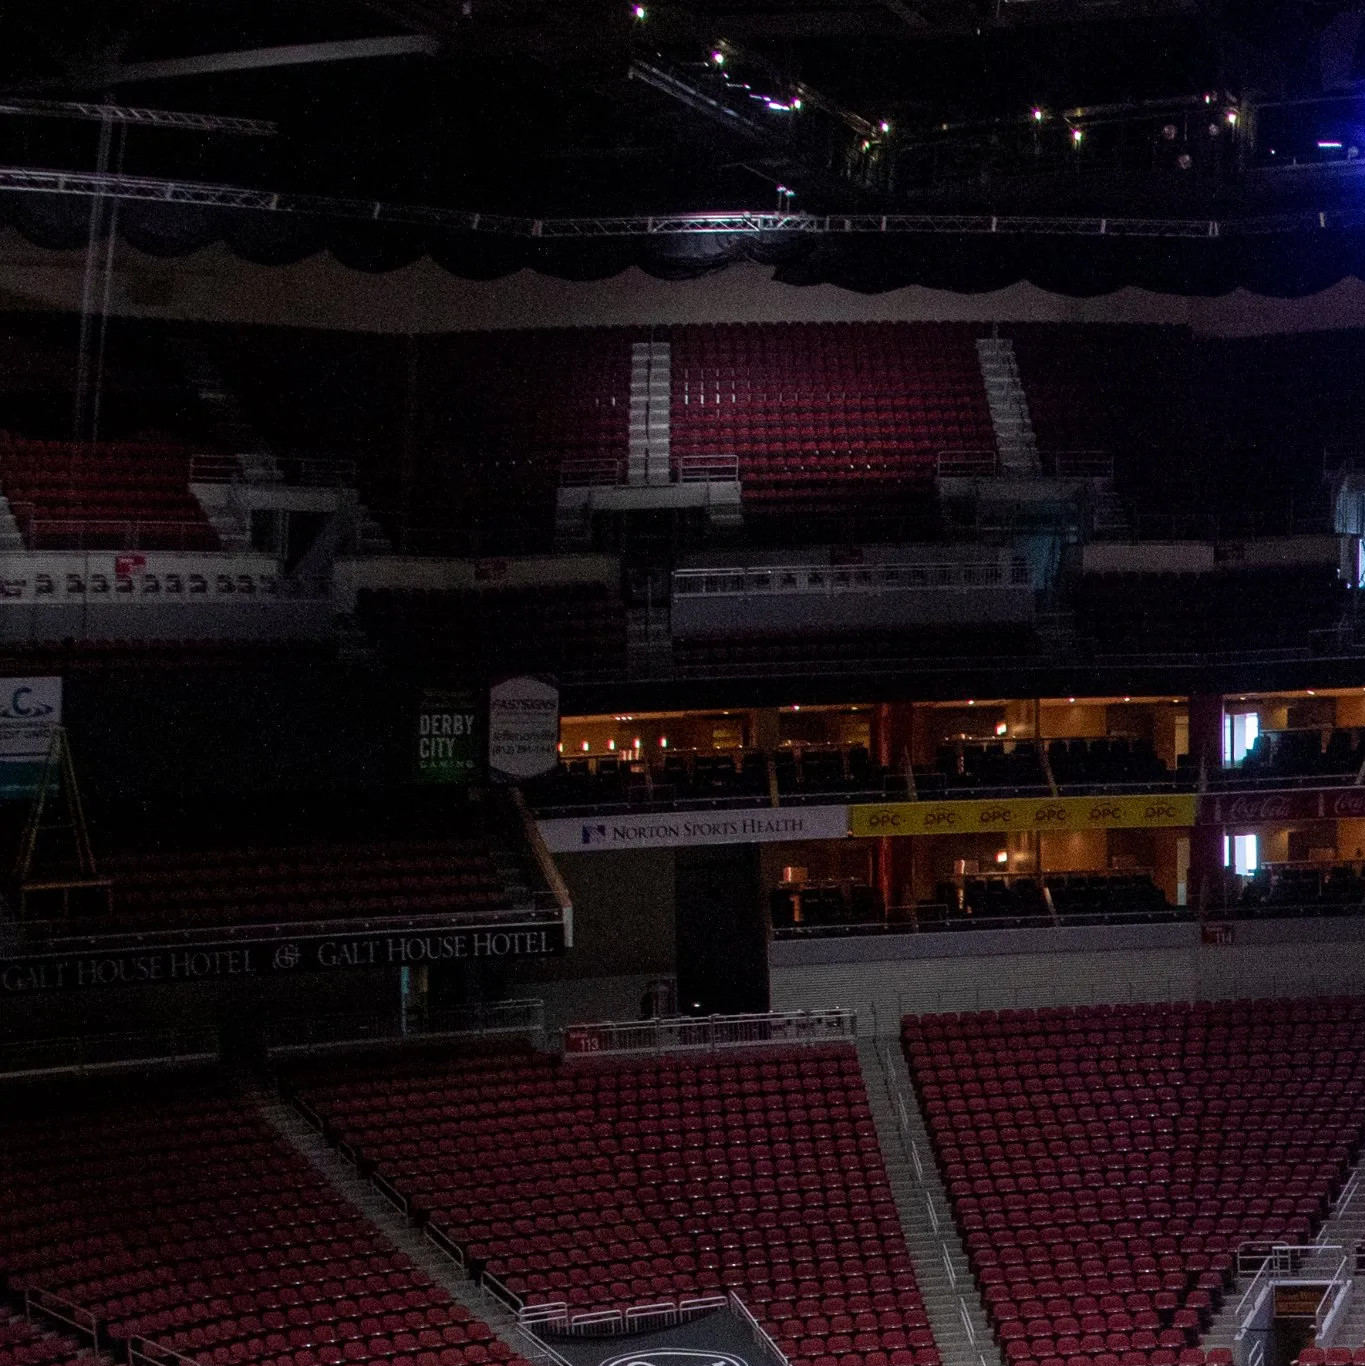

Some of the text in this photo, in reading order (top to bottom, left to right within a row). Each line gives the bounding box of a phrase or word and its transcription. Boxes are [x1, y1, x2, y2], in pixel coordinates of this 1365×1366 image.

[419, 714, 475, 735] DERBY
[419, 737, 456, 759] CITY
[613, 817, 803, 842] NORTON SPORTS HEALTH
[1215, 931, 1232, 943] 114
[318, 929, 556, 968] GALT HOUSE HOTEL
[3, 948, 255, 992] GALT HOUSE HOTEL
[580, 1038, 599, 1051] 113
